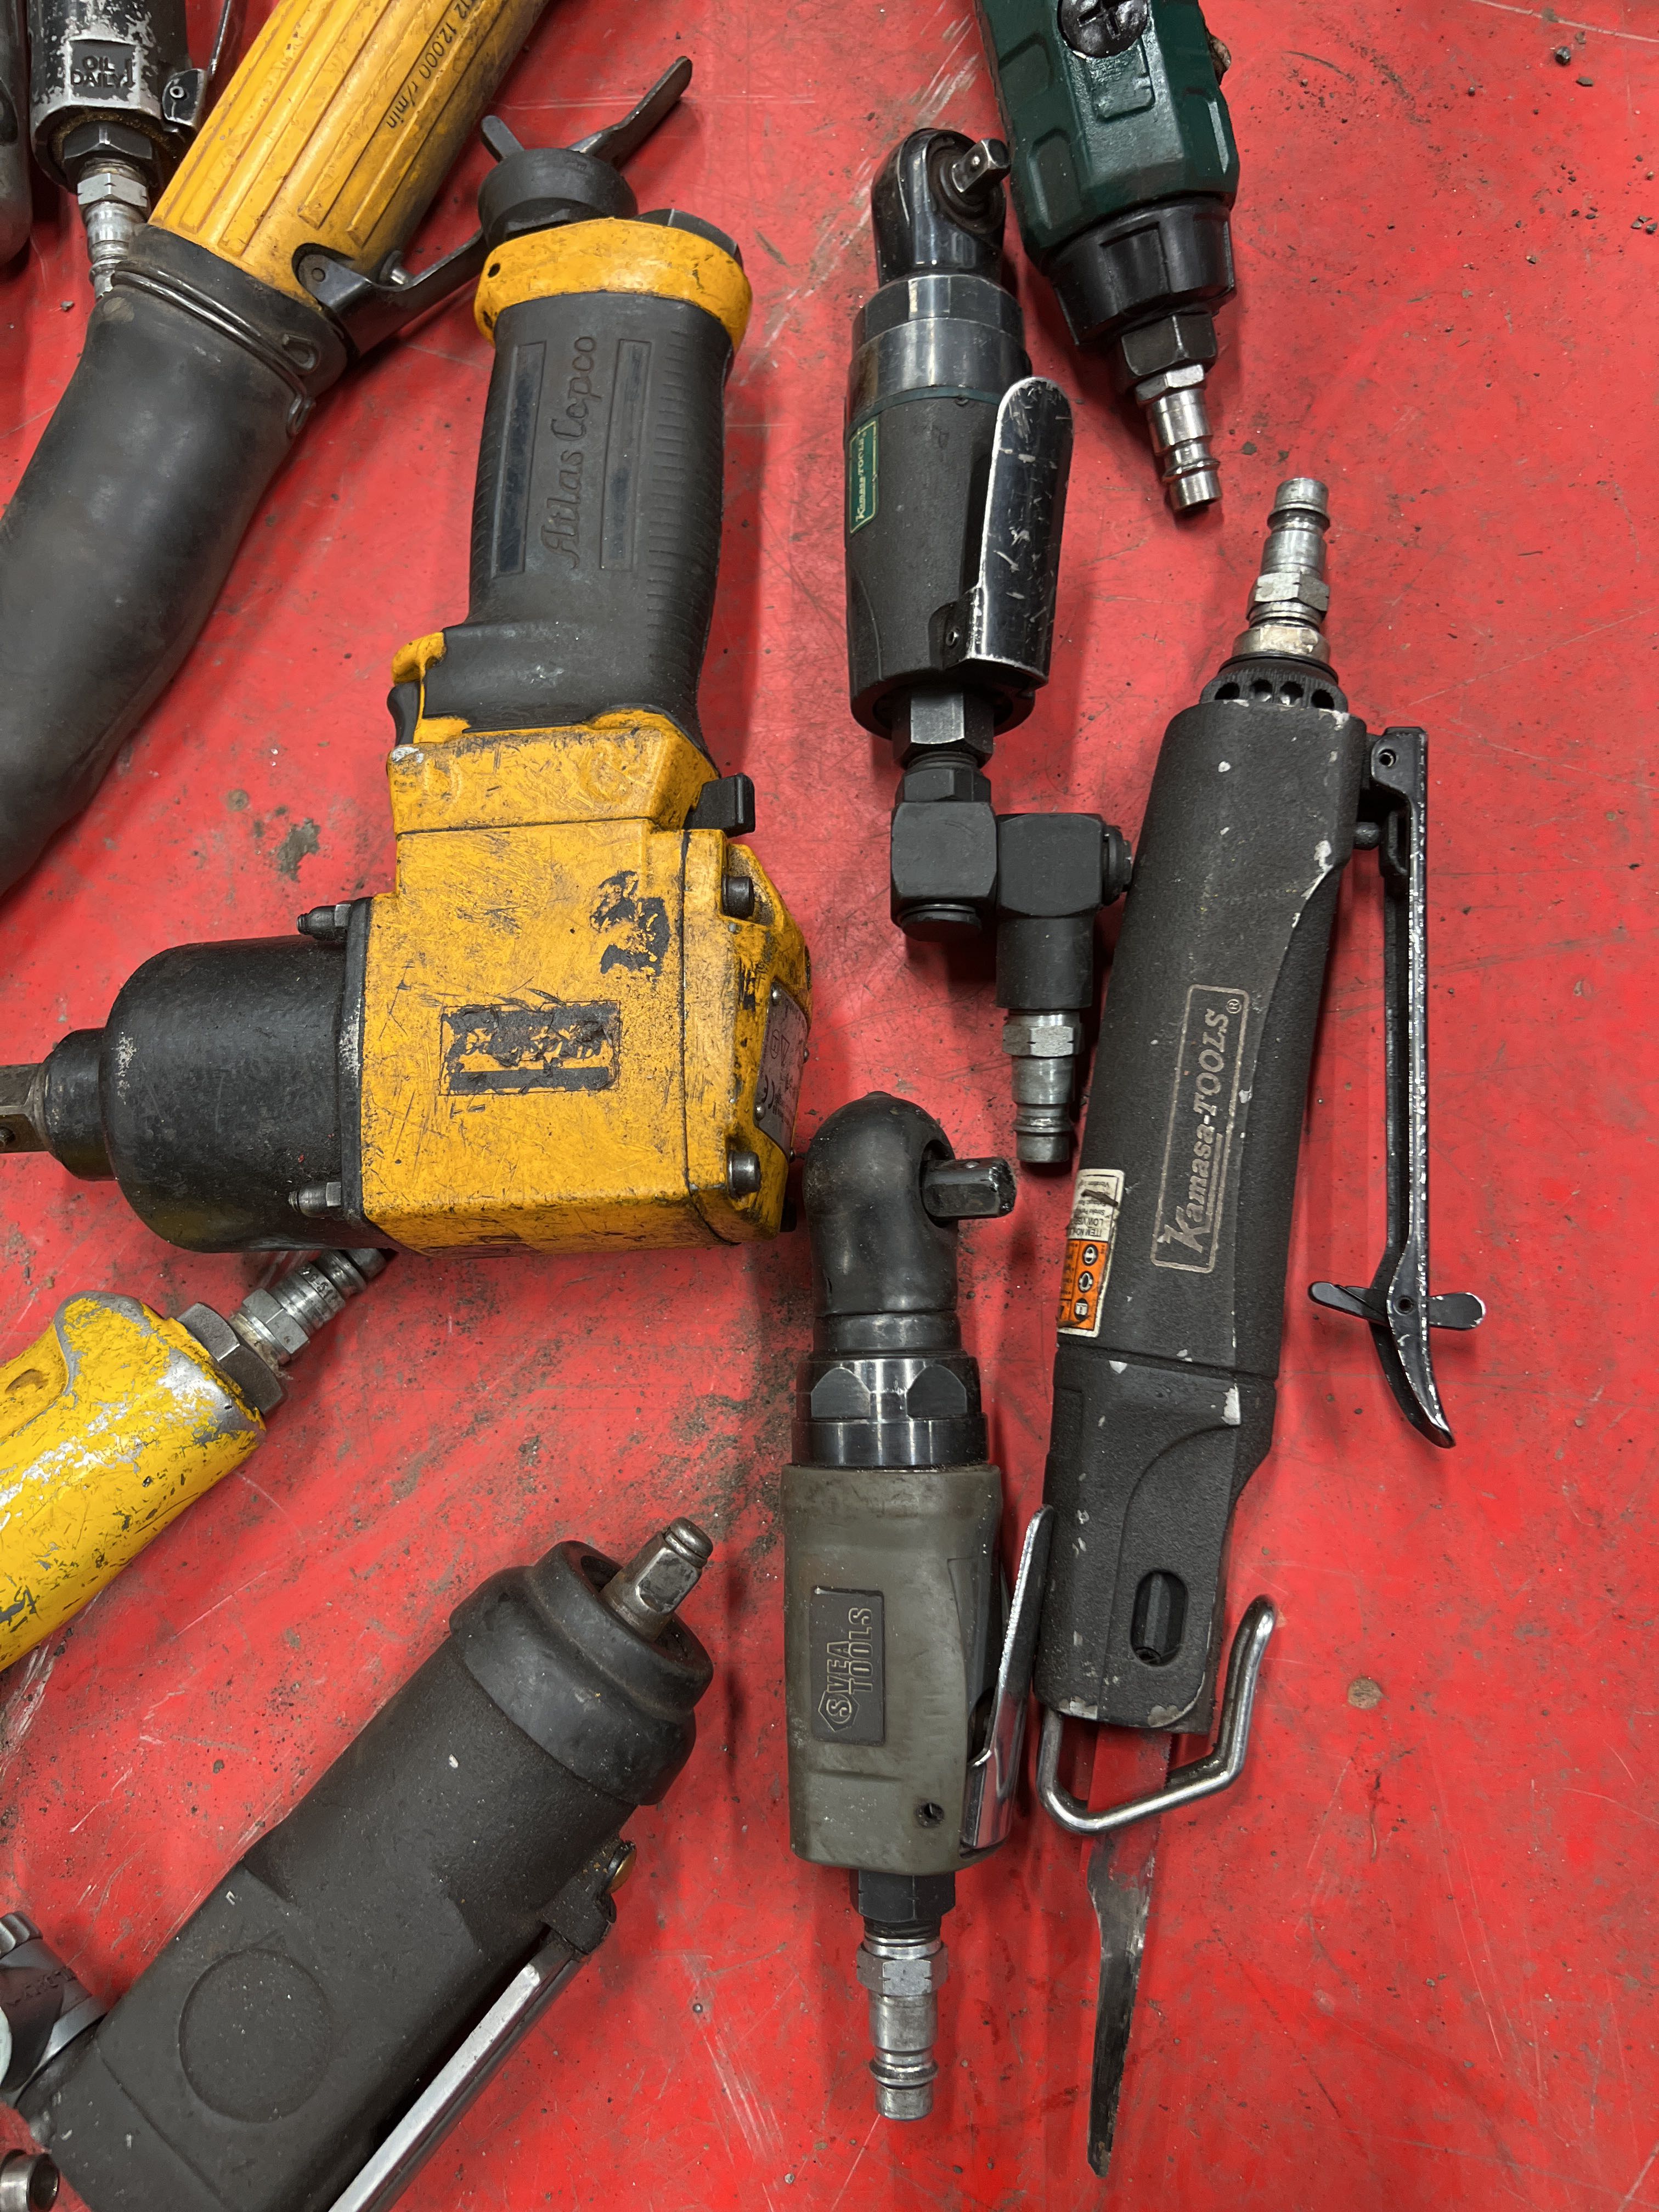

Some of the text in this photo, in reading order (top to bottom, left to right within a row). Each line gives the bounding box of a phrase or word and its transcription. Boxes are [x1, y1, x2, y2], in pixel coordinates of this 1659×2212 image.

[71, 71, 126, 88] DAILY
[83, 56, 115, 71] OIL
[386, 81, 419, 128] r/min
[540, 336, 602, 569] Atlas Copco
[848, 1607, 872, 1694] TOOLS
